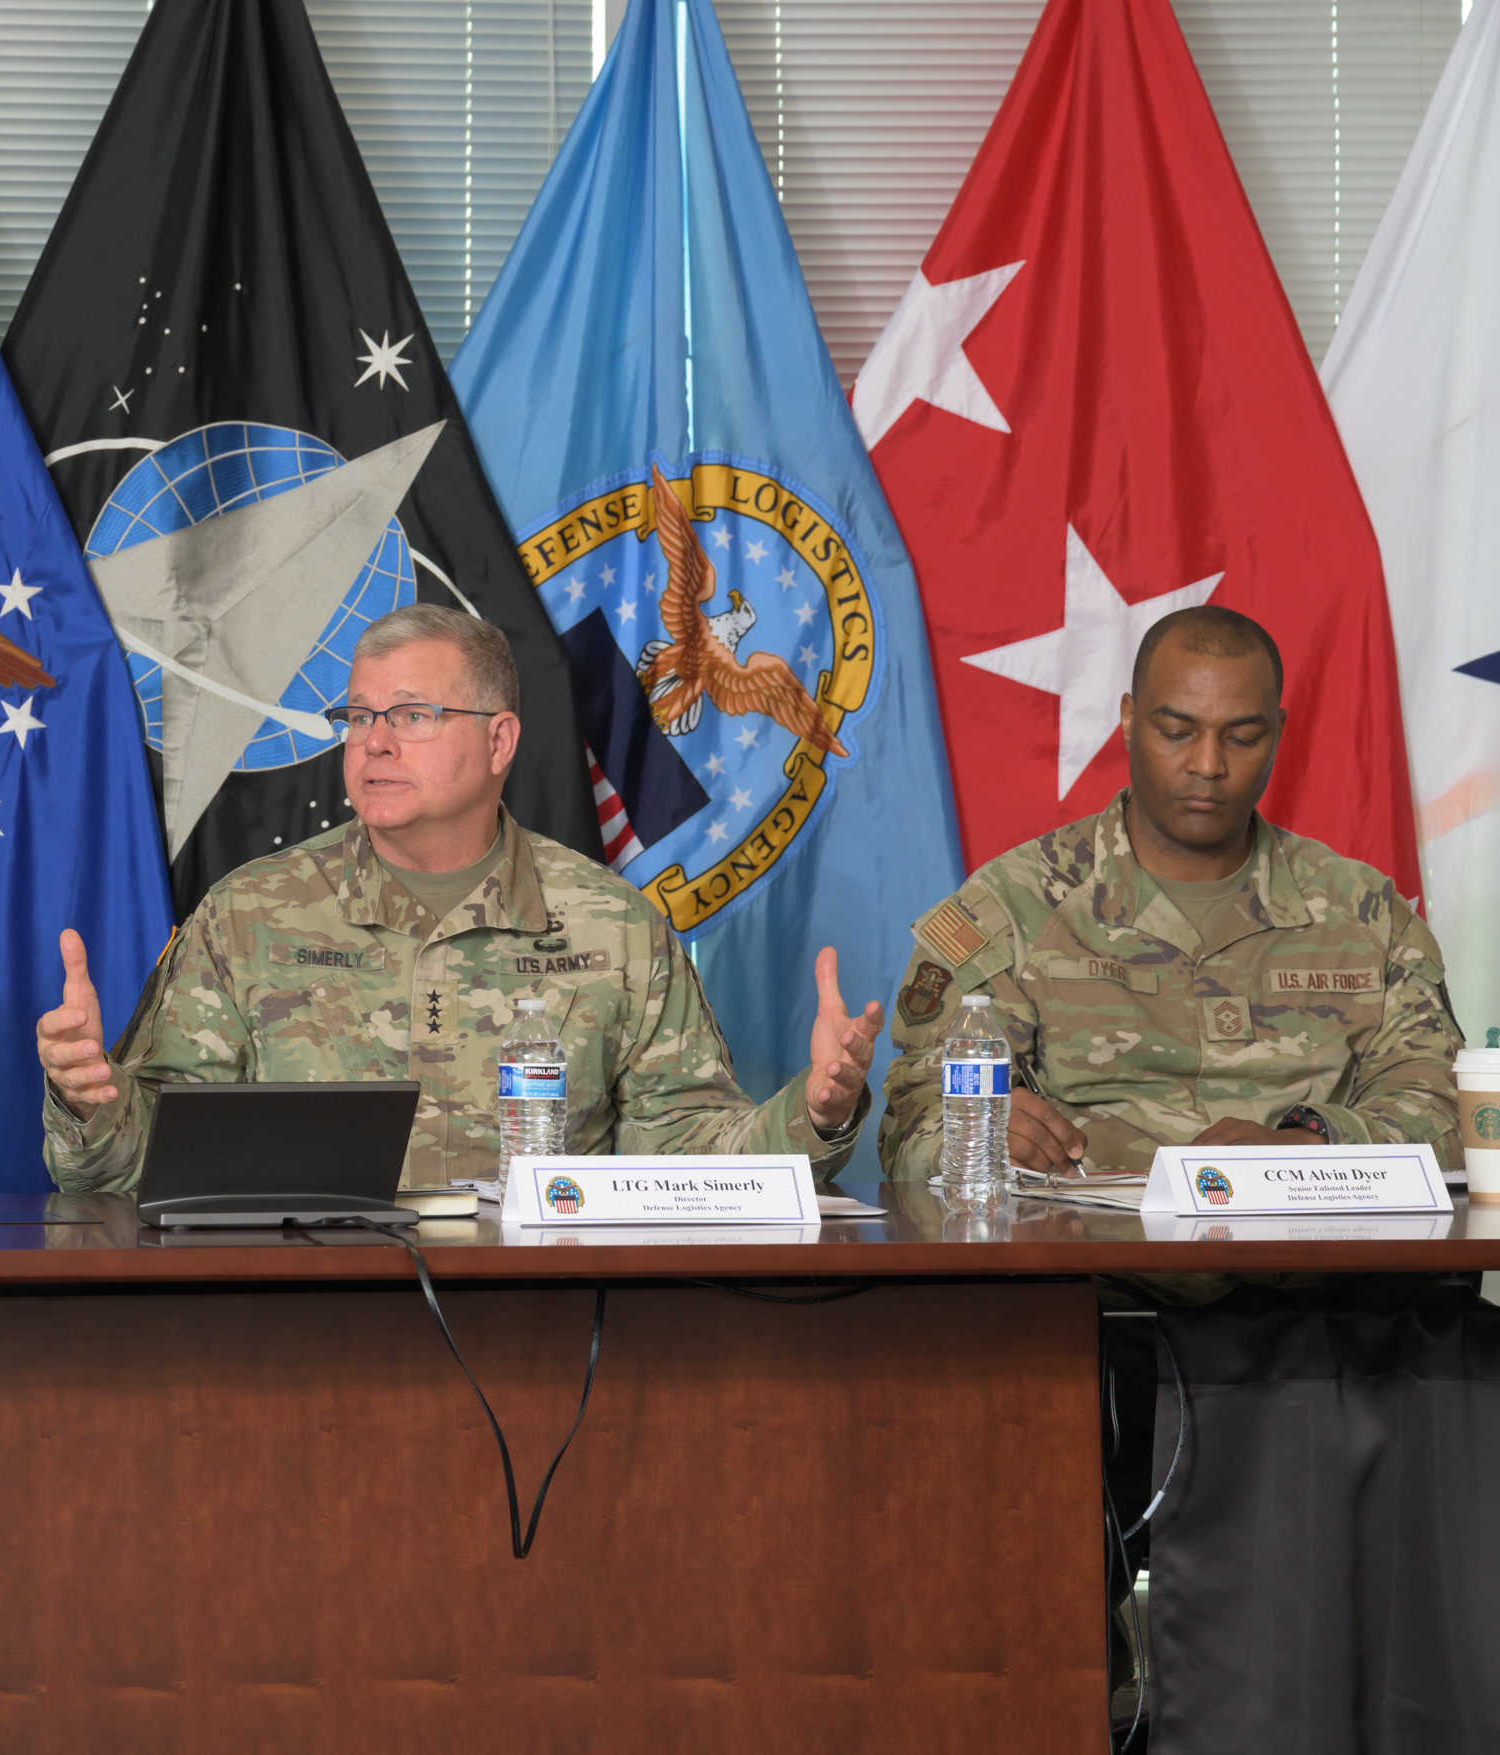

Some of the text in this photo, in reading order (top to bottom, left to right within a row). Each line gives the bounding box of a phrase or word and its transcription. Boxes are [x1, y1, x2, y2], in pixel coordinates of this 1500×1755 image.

[730, 475, 869, 662] LOGISTICS
[690, 777, 810, 916] AGENCY
[296, 948, 365, 968] SIMERLY
[516, 953, 590, 974] U.S. ARMY
[1088, 960, 1127, 980] DYER
[1278, 972, 1373, 990] U.S. AIR FORCE
[1264, 1168, 1388, 1183] CCM Alvin Dyer
[612, 1179, 764, 1194] LTG Mark Simerly
[1318, 1194, 1350, 1202] Logistics
[1352, 1193, 1379, 1201] Agency
[676, 1204, 711, 1212] Logistics
[713, 1204, 742, 1212] Agency
